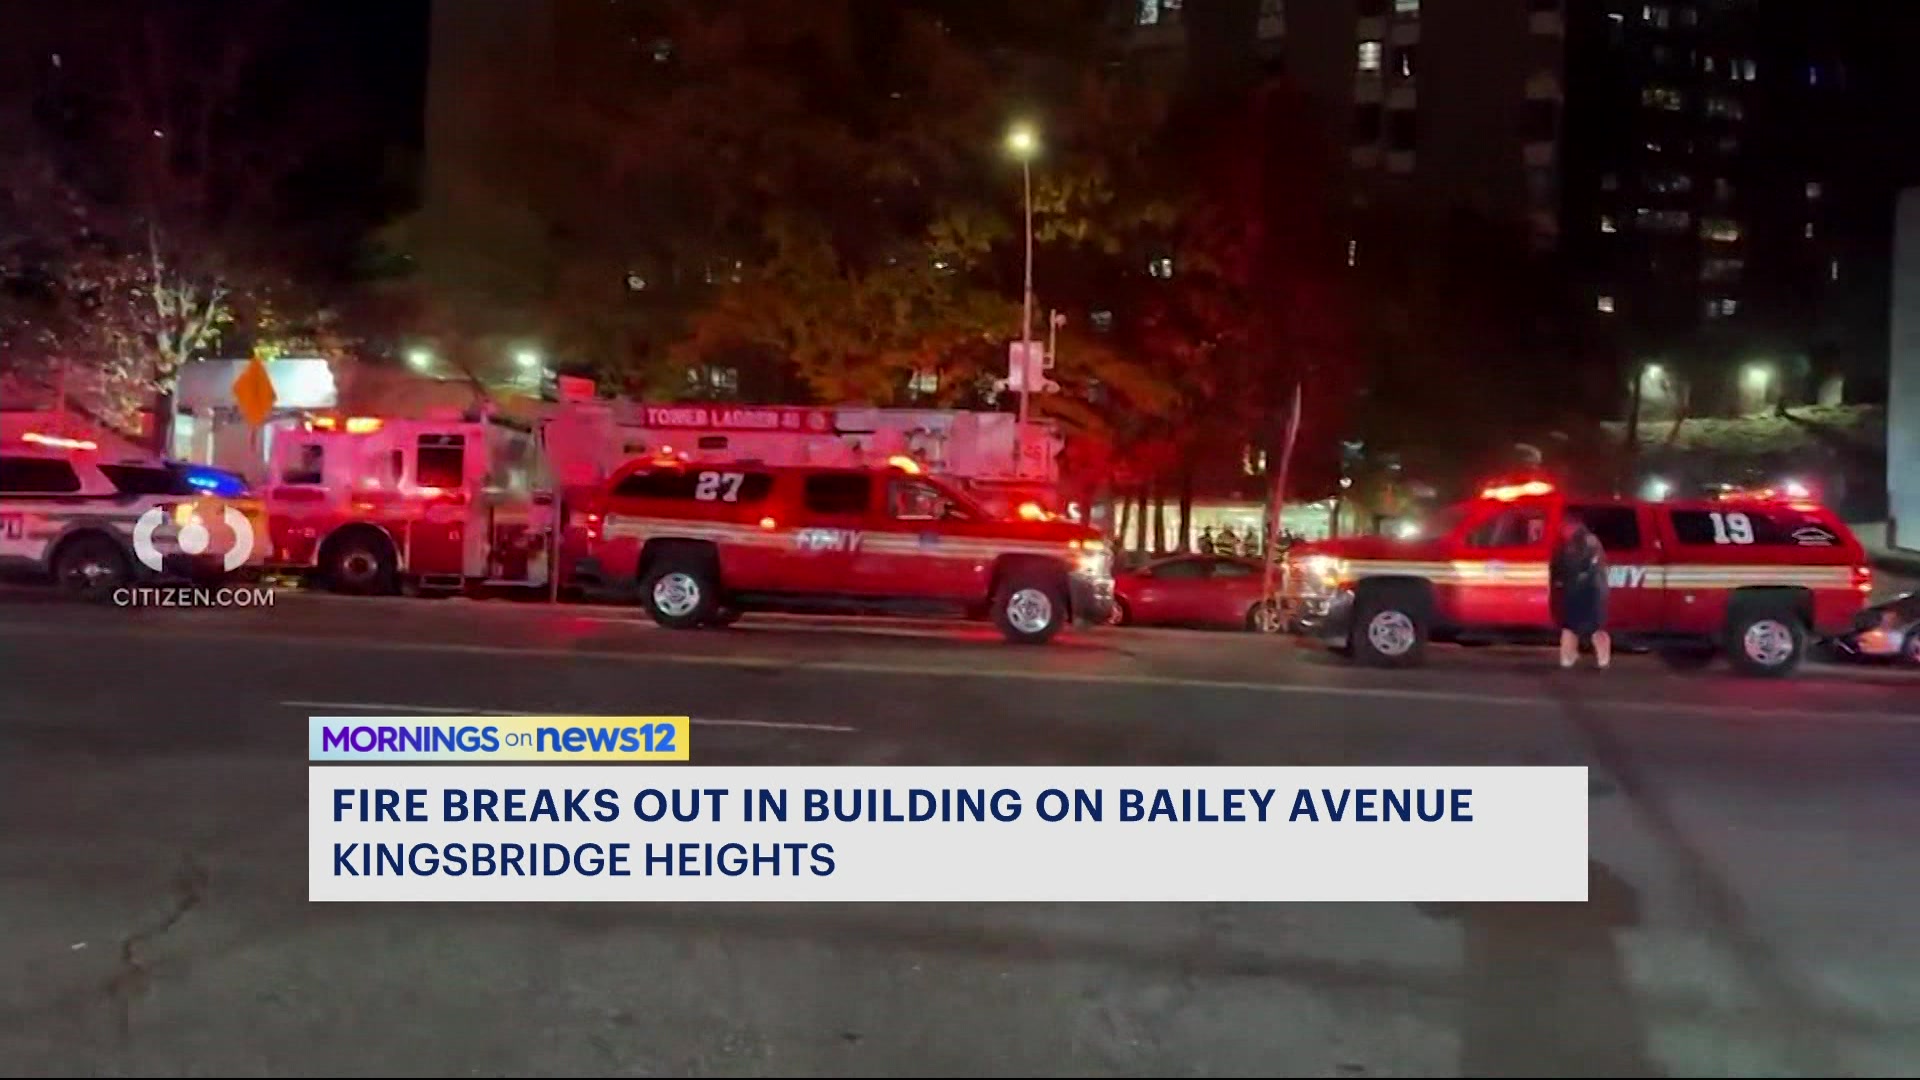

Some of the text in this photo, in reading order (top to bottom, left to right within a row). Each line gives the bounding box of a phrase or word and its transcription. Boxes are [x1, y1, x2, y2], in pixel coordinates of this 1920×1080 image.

[646, 408, 709, 427] TOWER
[695, 471, 745, 502] 27
[795, 528, 863, 551] FDNY
[1709, 513, 1756, 544] 19
[1606, 565, 1649, 588] NY
